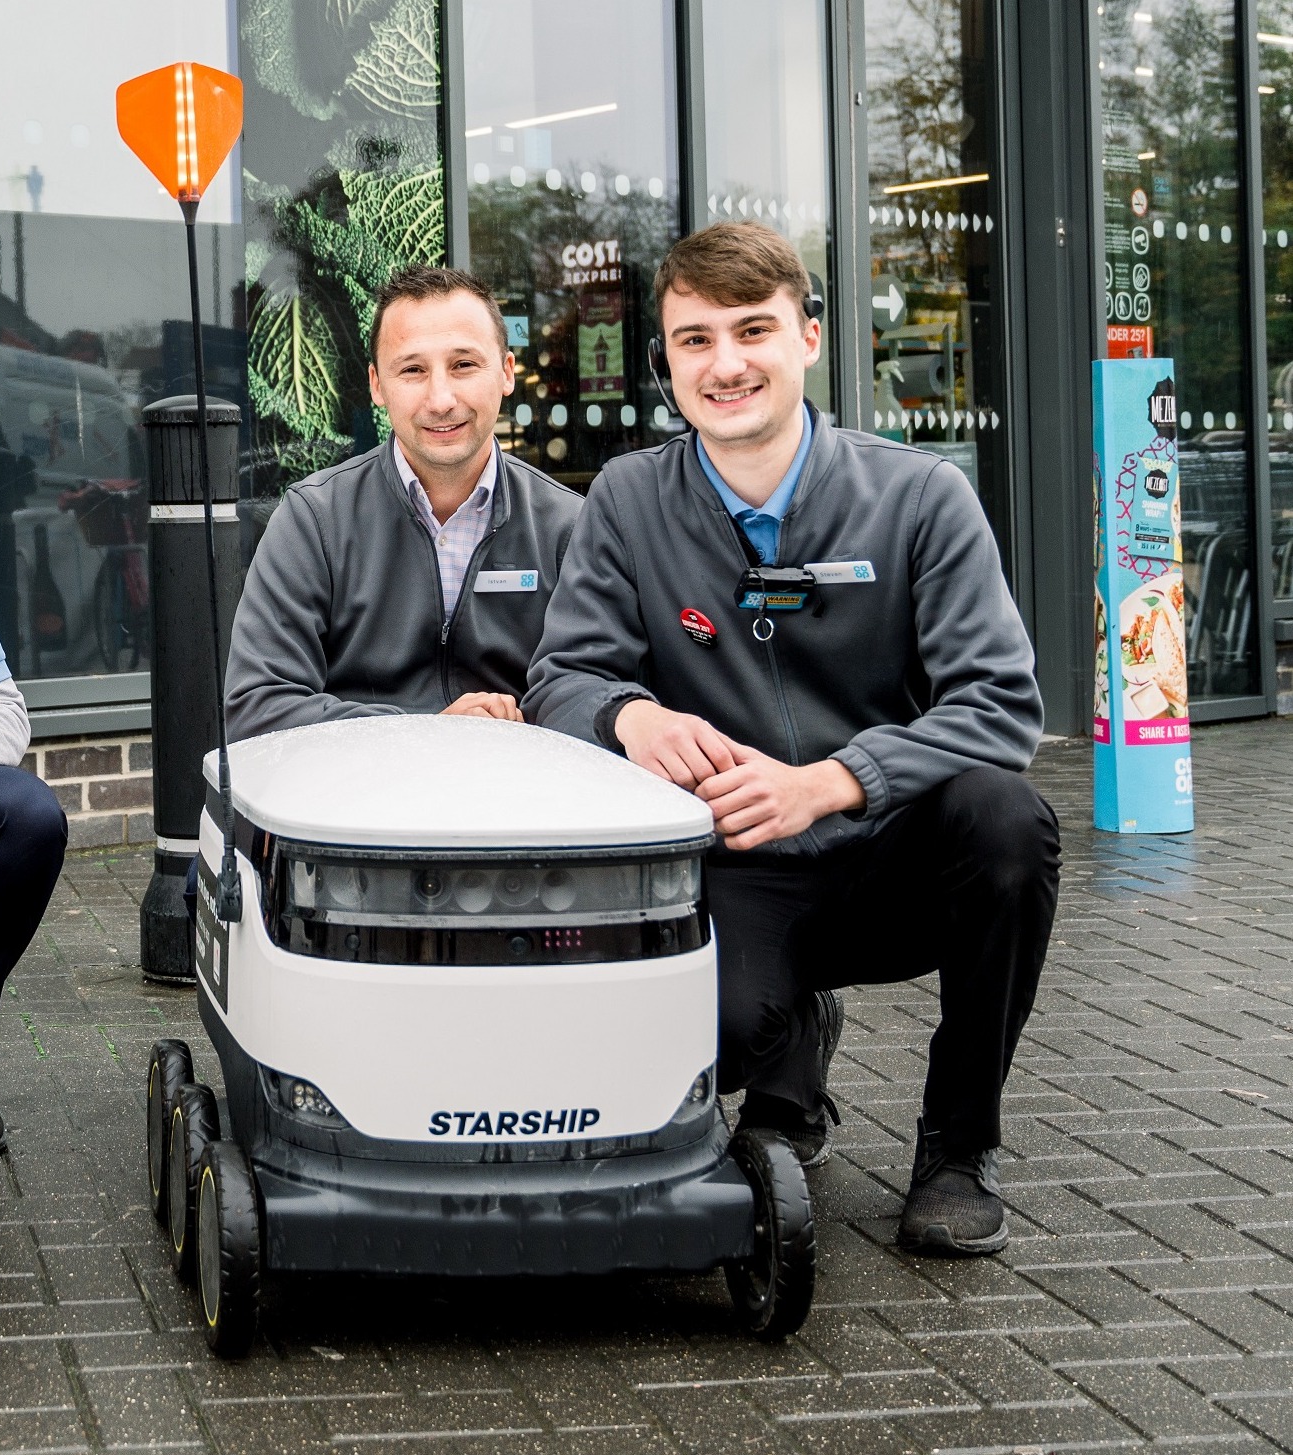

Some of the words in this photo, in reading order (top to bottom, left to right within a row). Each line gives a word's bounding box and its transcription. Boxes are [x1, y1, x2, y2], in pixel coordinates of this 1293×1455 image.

[573, 268, 622, 285] EXPRE
[1106, 327, 1129, 342] NDER
[1130, 328, 1146, 342] 25?
[819, 570, 843, 578] Steven
[1138, 726, 1165, 739] SHARE
[1167, 725, 1173, 738] A
[427, 1107, 601, 1136] STARSHIP
